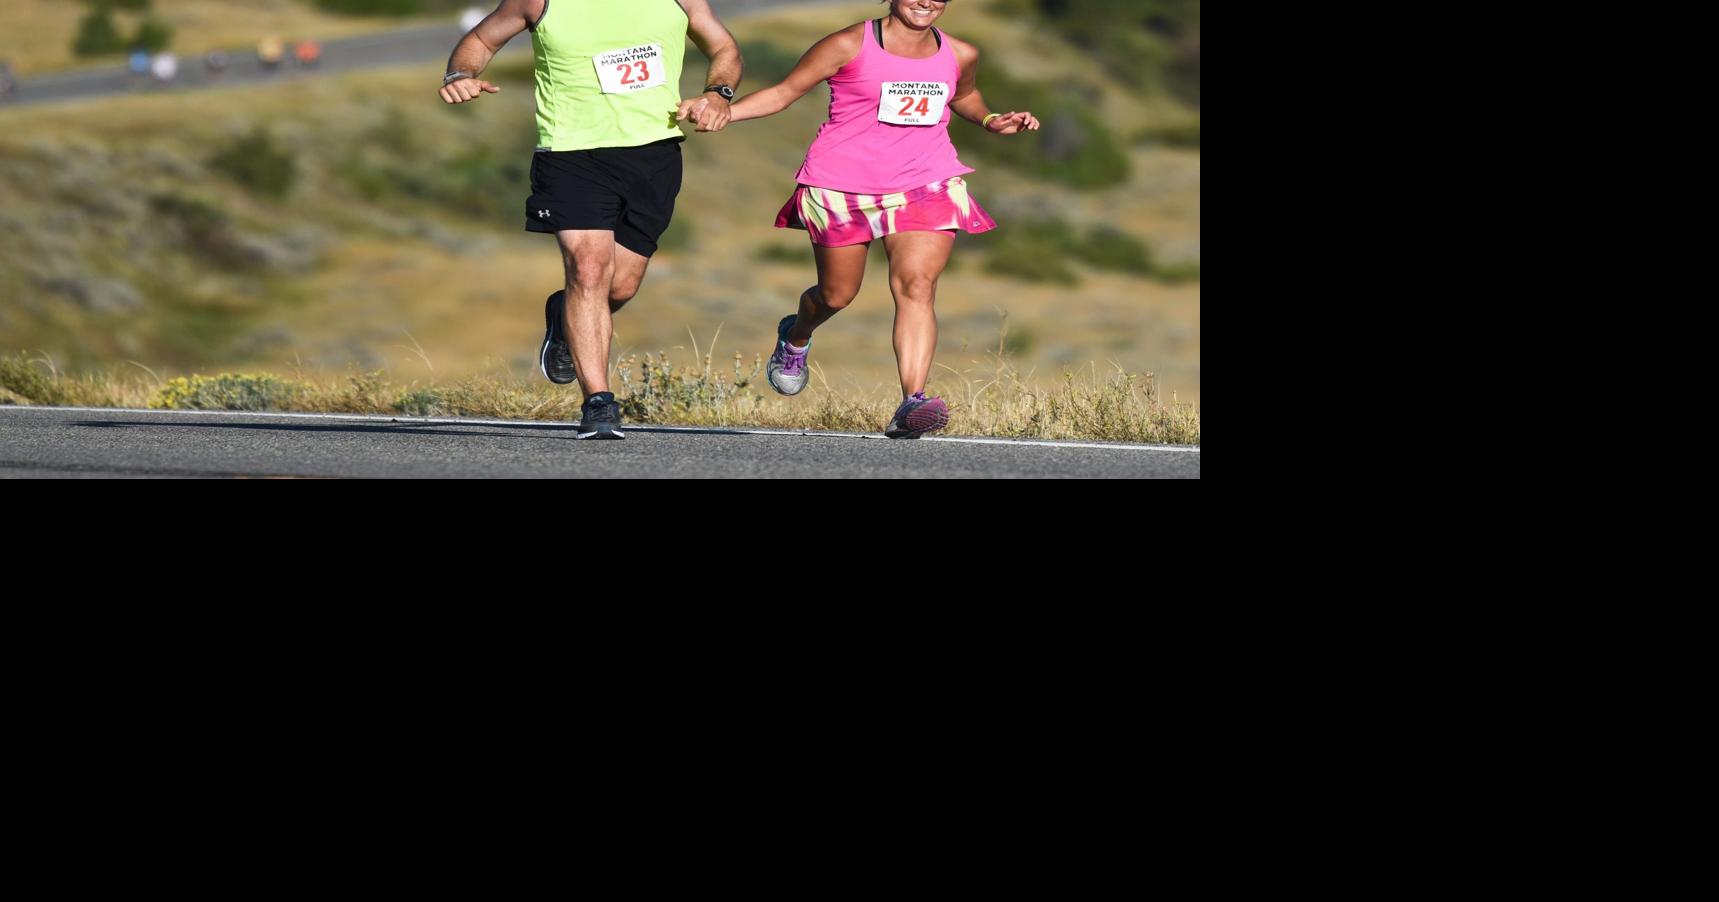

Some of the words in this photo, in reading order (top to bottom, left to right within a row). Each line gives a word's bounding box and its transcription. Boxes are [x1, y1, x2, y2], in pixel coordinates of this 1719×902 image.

[601, 51, 657, 66] MARATHON
[616, 60, 650, 85] 23
[898, 96, 929, 116] 24
